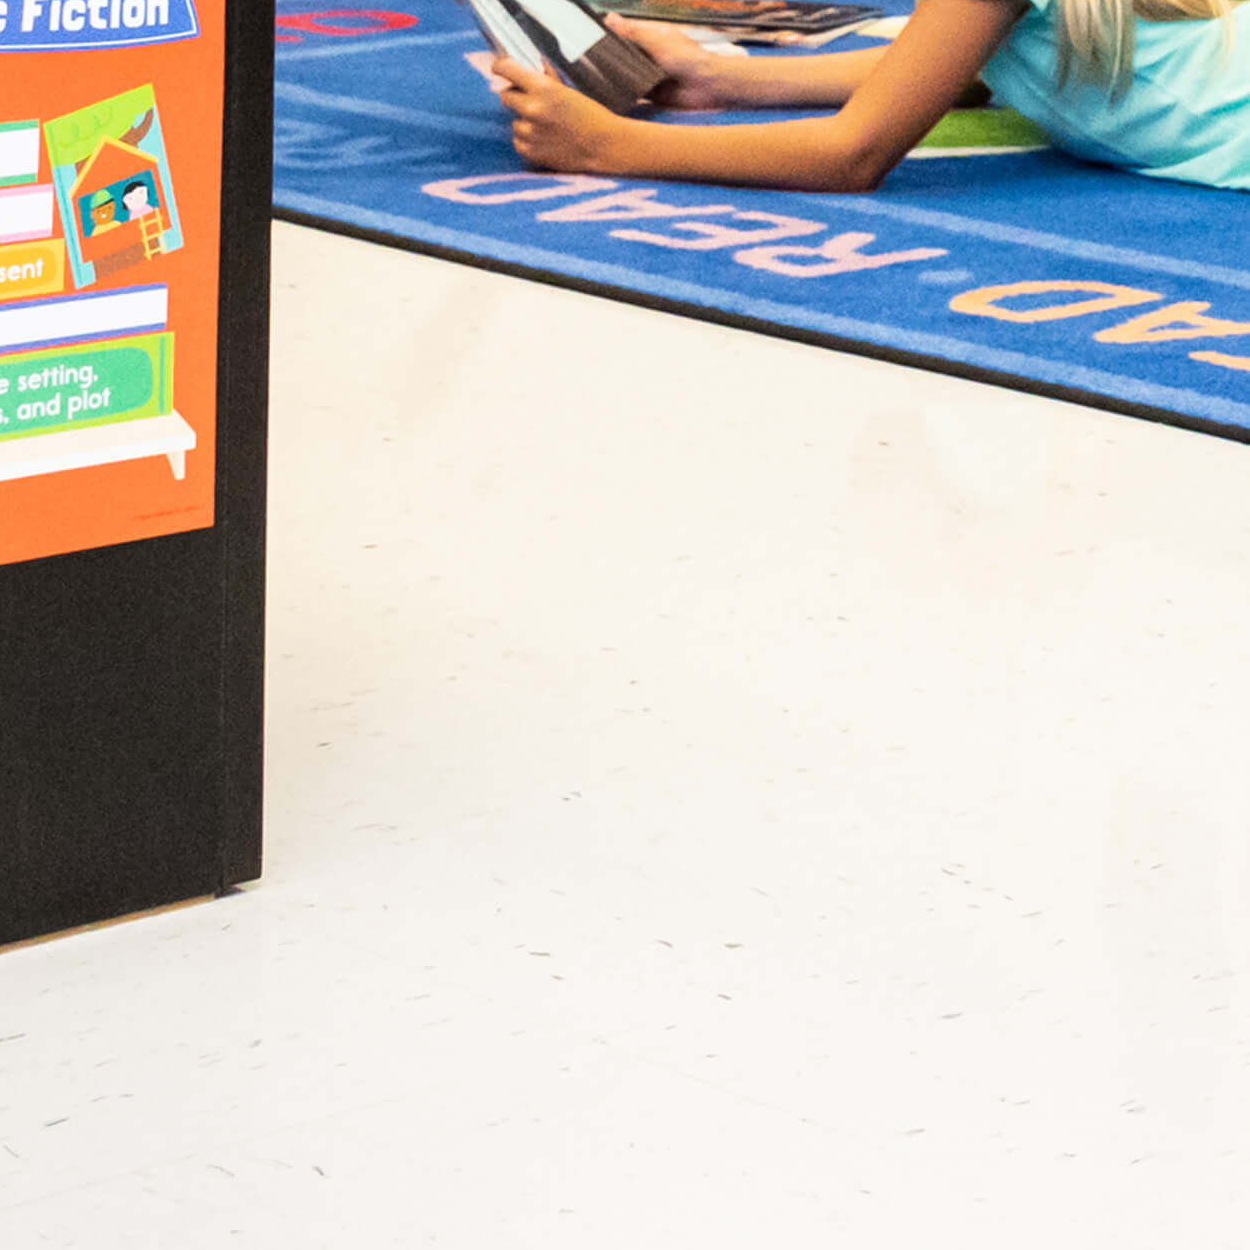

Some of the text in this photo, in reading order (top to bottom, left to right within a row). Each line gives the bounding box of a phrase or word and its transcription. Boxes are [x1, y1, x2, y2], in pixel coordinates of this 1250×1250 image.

[421, 173, 948, 278] READ
[949, 280, 1250, 372] AD
[17, 363, 99, 392] setting,
[17, 396, 61, 420] and
[67, 387, 111, 419] plot
